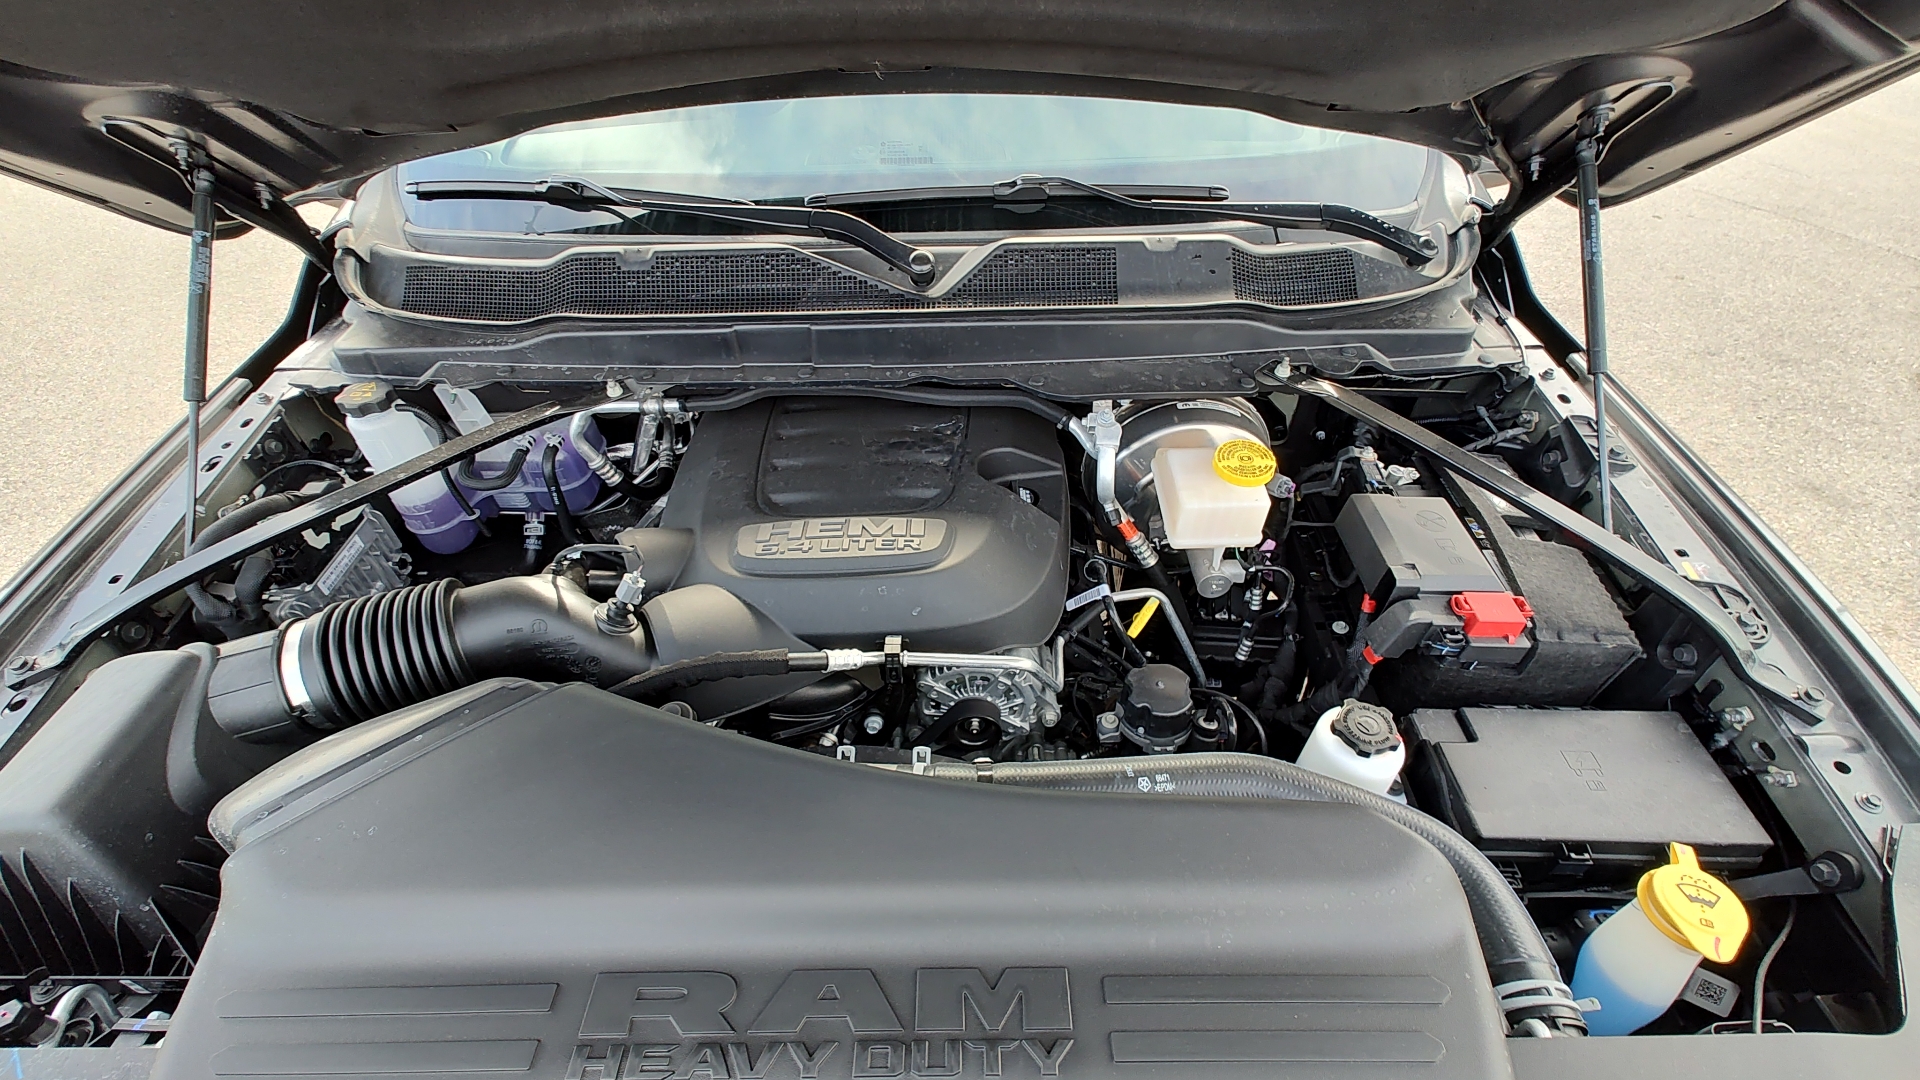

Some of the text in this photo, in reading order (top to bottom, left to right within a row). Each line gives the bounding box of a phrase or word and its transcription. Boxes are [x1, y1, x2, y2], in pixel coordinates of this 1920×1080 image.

[755, 518, 926, 542] HEMI
[755, 537, 921, 556] 6.4 LITER
[579, 967, 1074, 1037] RAM
[564, 1039, 1075, 1080] HEAVY DUTY
